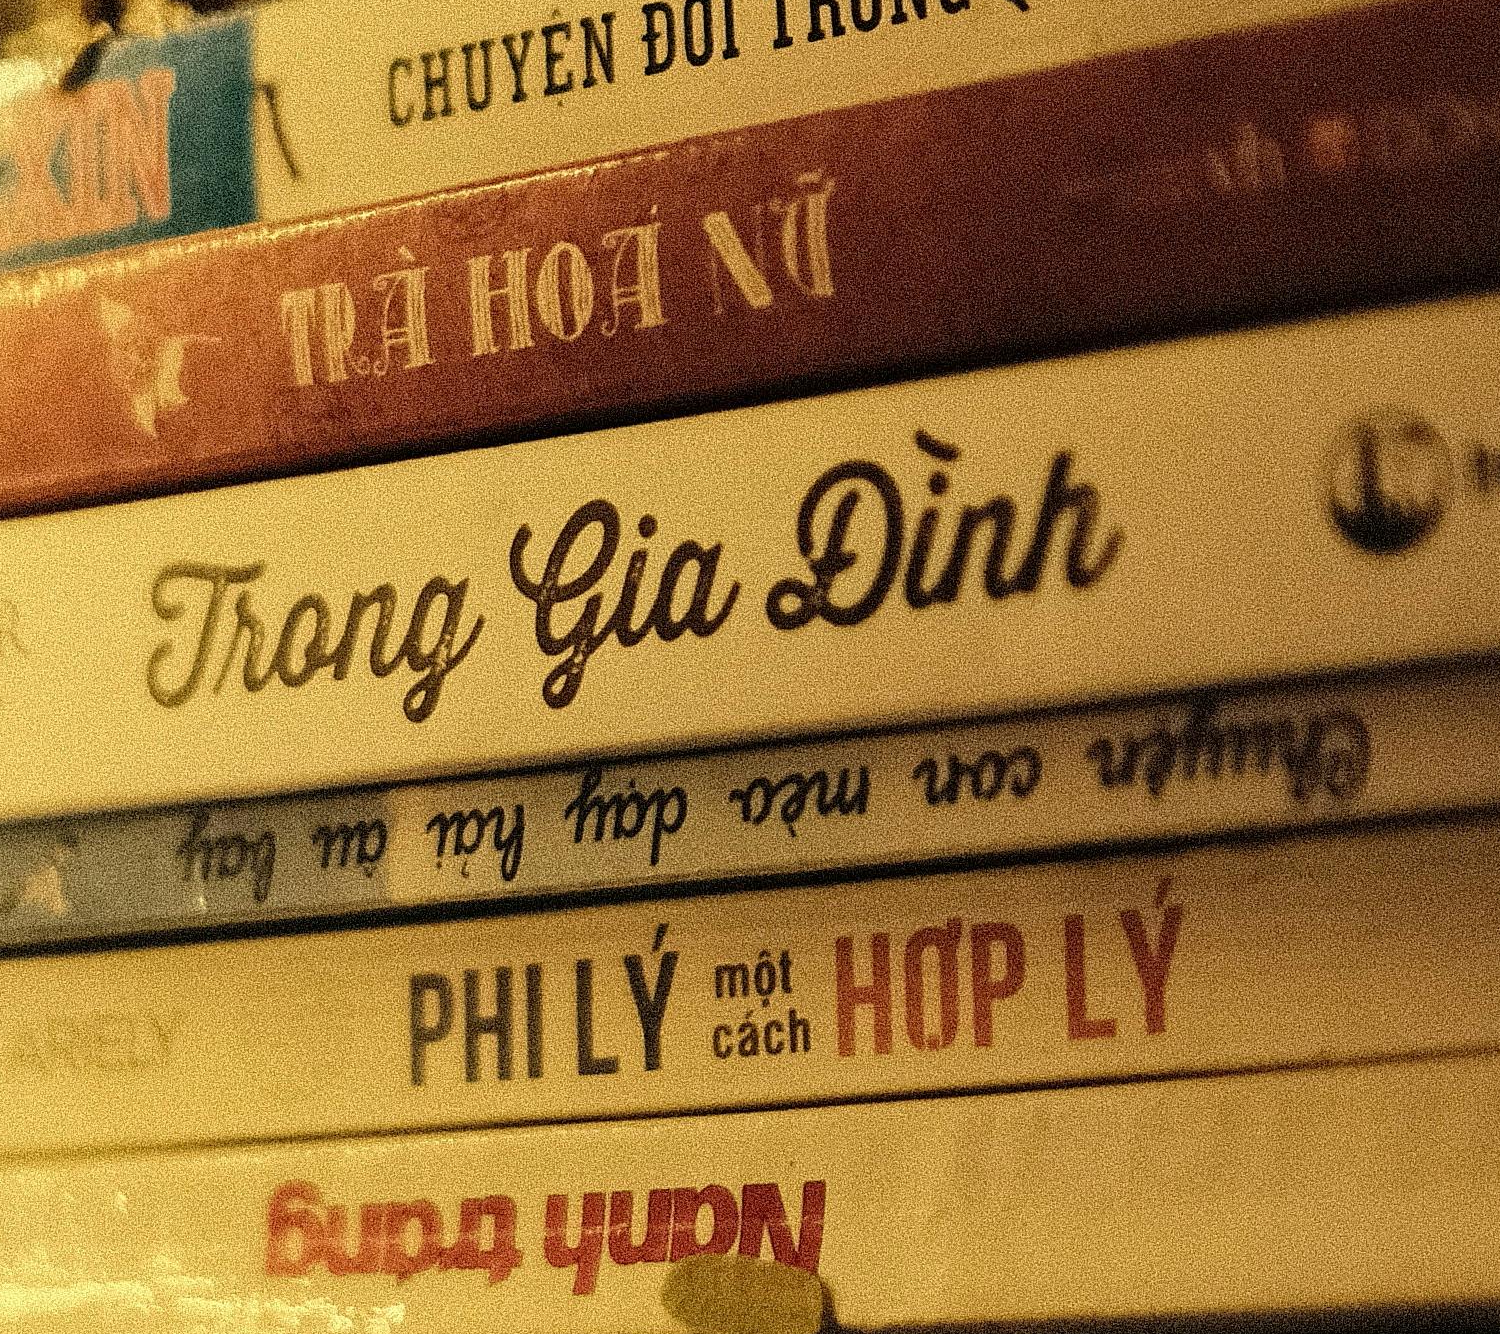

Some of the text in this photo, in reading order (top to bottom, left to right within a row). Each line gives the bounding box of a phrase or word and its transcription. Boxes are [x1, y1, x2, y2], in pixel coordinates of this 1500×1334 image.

[386, 5, 618, 130] CHUYỆN
[278, 246, 436, 388] TRÀ
[145, 557, 487, 725] Trong
[507, 496, 742, 711] Gia
[765, 428, 1126, 633] Đình
[726, 764, 871, 838] mèo
[911, 745, 1044, 807] con
[1085, 697, 1373, 805] Chuyện
[176, 810, 277, 904] bay
[424, 801, 526, 883] hải
[562, 766, 690, 867] dạy
[407, 961, 544, 1087] PHI
[573, 922, 681, 1077] LÝ
[711, 948, 795, 1002] một
[833, 917, 1027, 1058] HỢP
[1063, 875, 1185, 1041] LÝ
[710, 1007, 812, 1061] cách
[541, 1179, 828, 1295] Nanh
